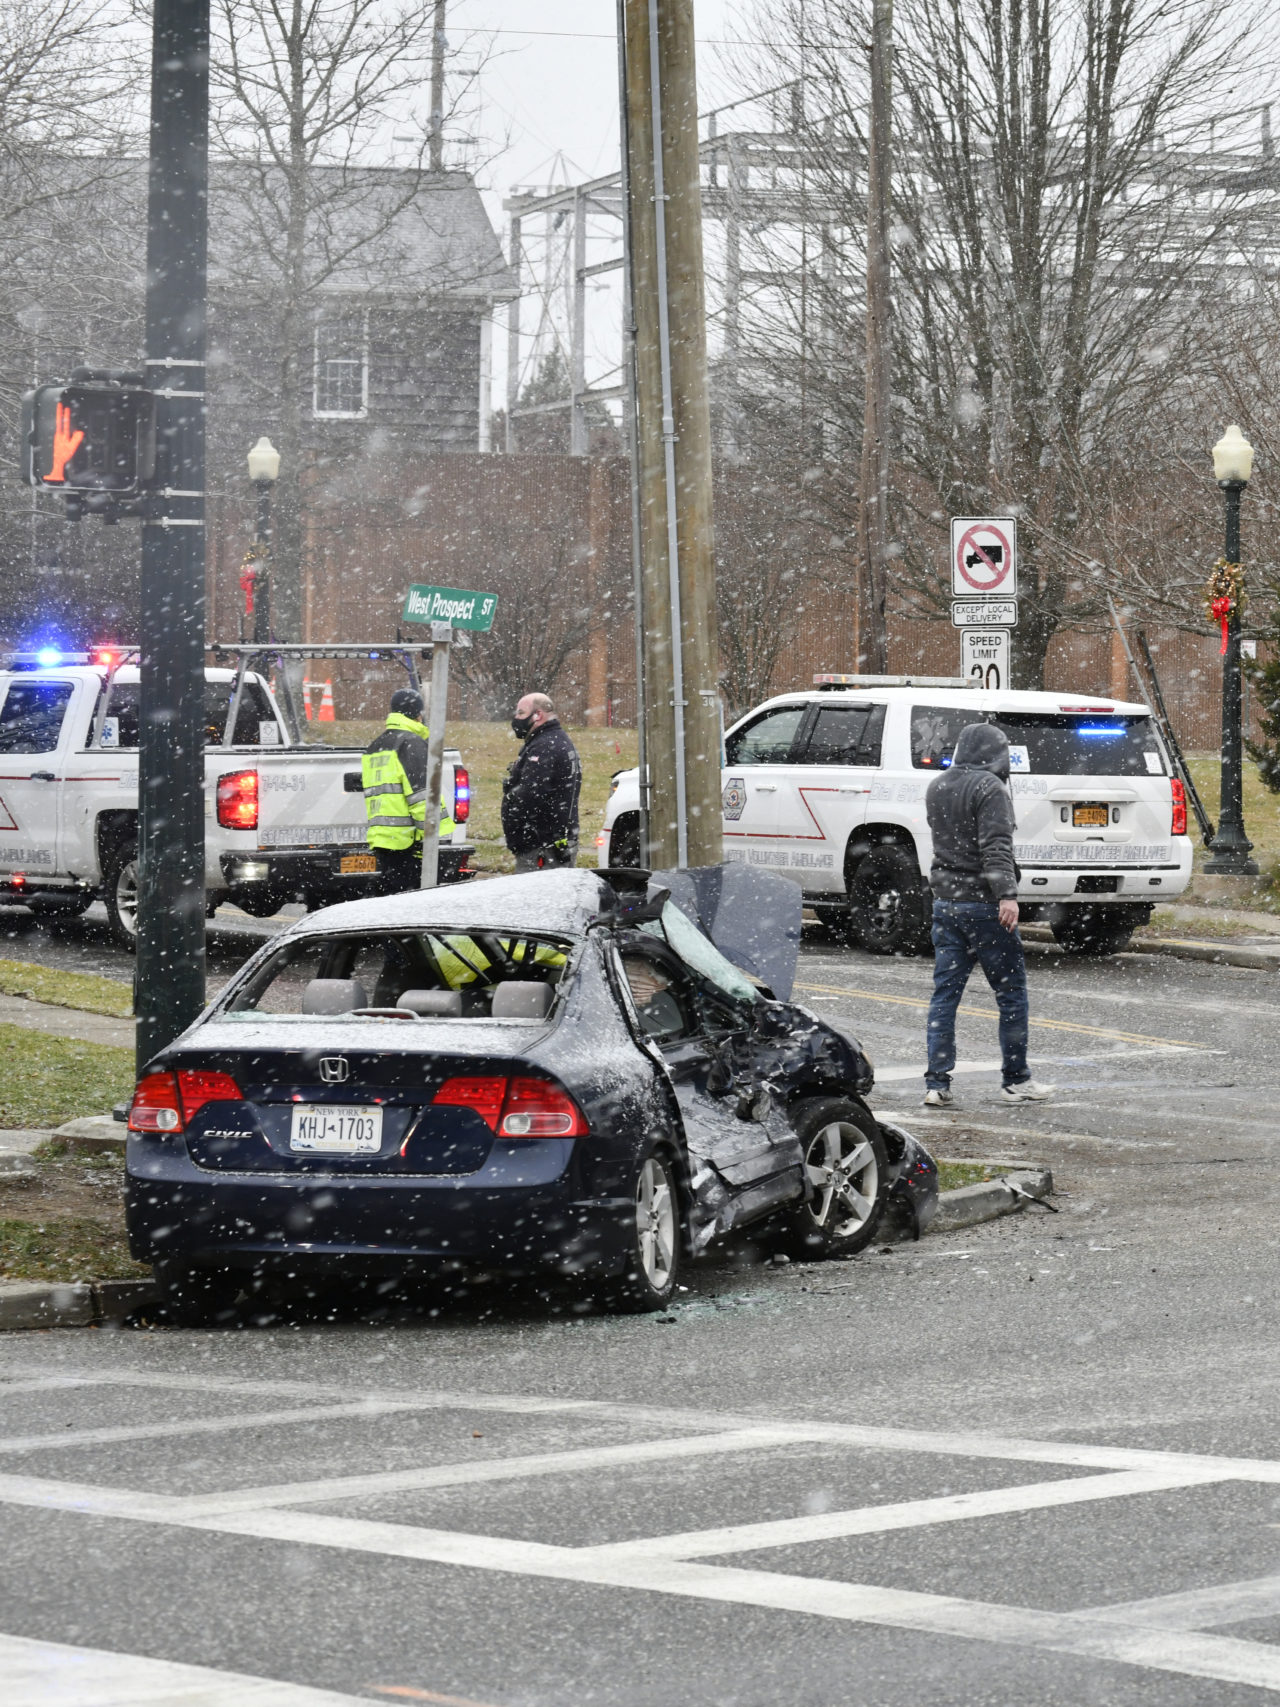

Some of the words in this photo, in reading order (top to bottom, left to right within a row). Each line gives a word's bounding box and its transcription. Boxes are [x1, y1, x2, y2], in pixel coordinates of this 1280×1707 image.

[408, 591, 431, 614] West
[431, 593, 475, 623] Prospect
[481, 598, 494, 615] ST
[956, 605, 985, 614] EXCEPT
[987, 605, 1013, 613] LOCAL
[966, 614, 1002, 622] DELIVERY
[969, 636, 1002, 646] SPEED
[972, 649, 998, 659] LIMIT
[316, 1107, 335, 1116] NEW
[337, 1108, 360, 1116] YORK
[203, 1130, 253, 1139] CIVIC
